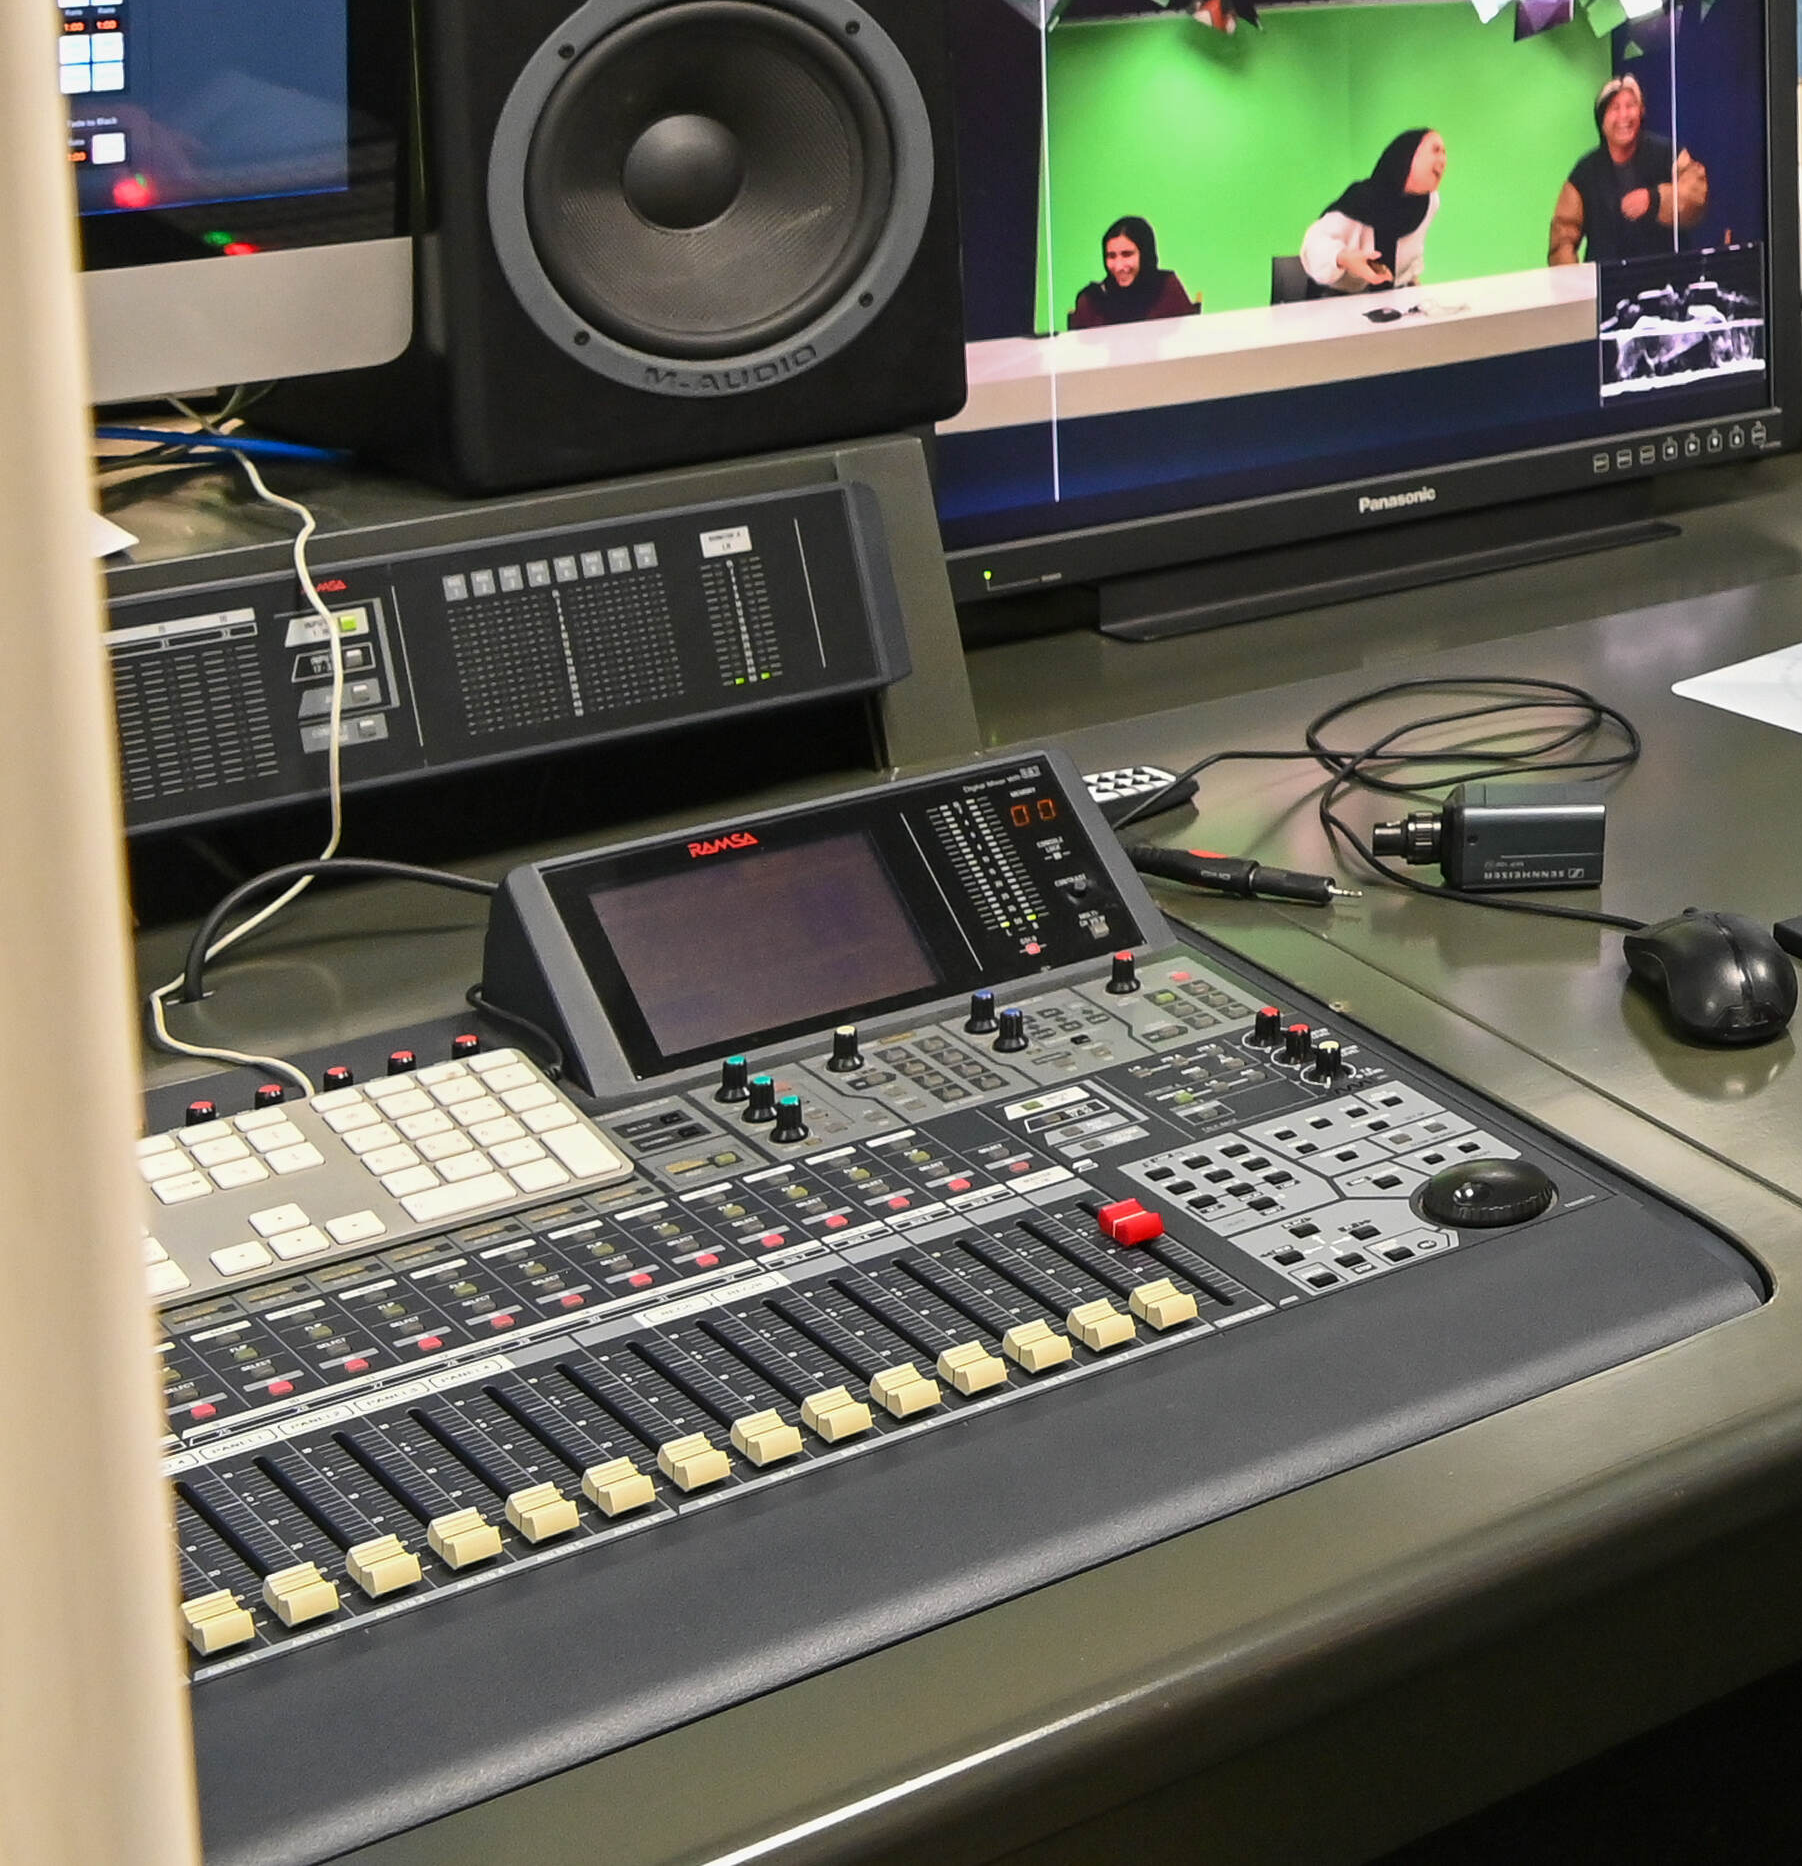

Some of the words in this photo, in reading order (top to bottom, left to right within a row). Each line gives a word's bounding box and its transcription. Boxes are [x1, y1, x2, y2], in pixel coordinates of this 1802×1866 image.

[1359, 485, 1436, 513] Panasonic
[688, 831, 758, 858] RAMSA
[1484, 870, 1565, 879] SENNHEISER
